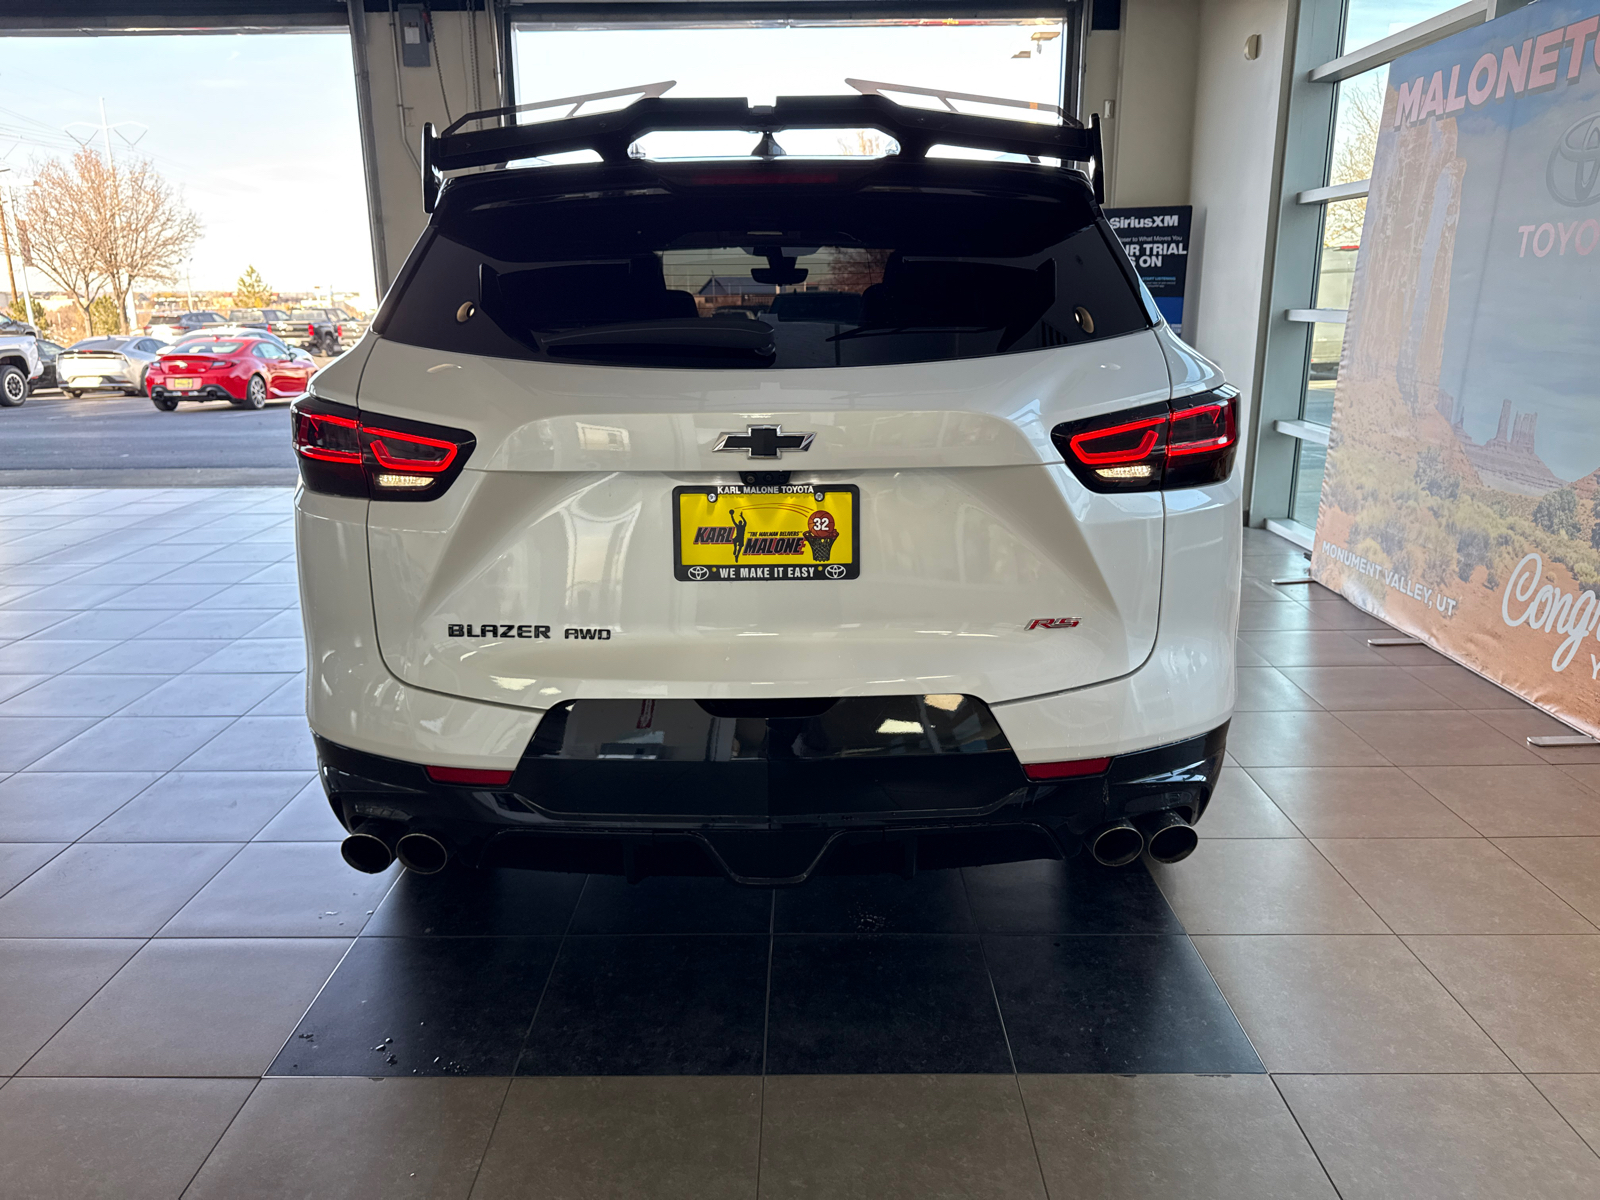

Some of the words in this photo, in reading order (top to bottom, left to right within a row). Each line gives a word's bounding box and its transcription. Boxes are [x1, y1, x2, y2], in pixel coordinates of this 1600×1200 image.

[1109, 215, 1179, 229] SiriusXM
[1143, 243, 1188, 255] TRIAL
[1139, 255, 1163, 268] ON
[717, 486, 741, 494] KARL
[743, 486, 779, 494] MALONE
[781, 486, 814, 494] TOYOTA
[813, 517, 829, 531] 32
[693, 526, 736, 545] KARL
[742, 537, 806, 556] MALONE
[719, 567, 737, 579] WE
[740, 566, 770, 578] MAKE
[774, 566, 784, 578] IT
[787, 566, 815, 578] EASY
[1322, 540, 1382, 580] MONUMENT
[1384, 568, 1433, 609] VALLEY,
[1436, 594, 1457, 616] UT
[1024, 617, 1082, 631] RS
[448, 624, 551, 639] BLAZER
[564, 628, 611, 640] AWD
